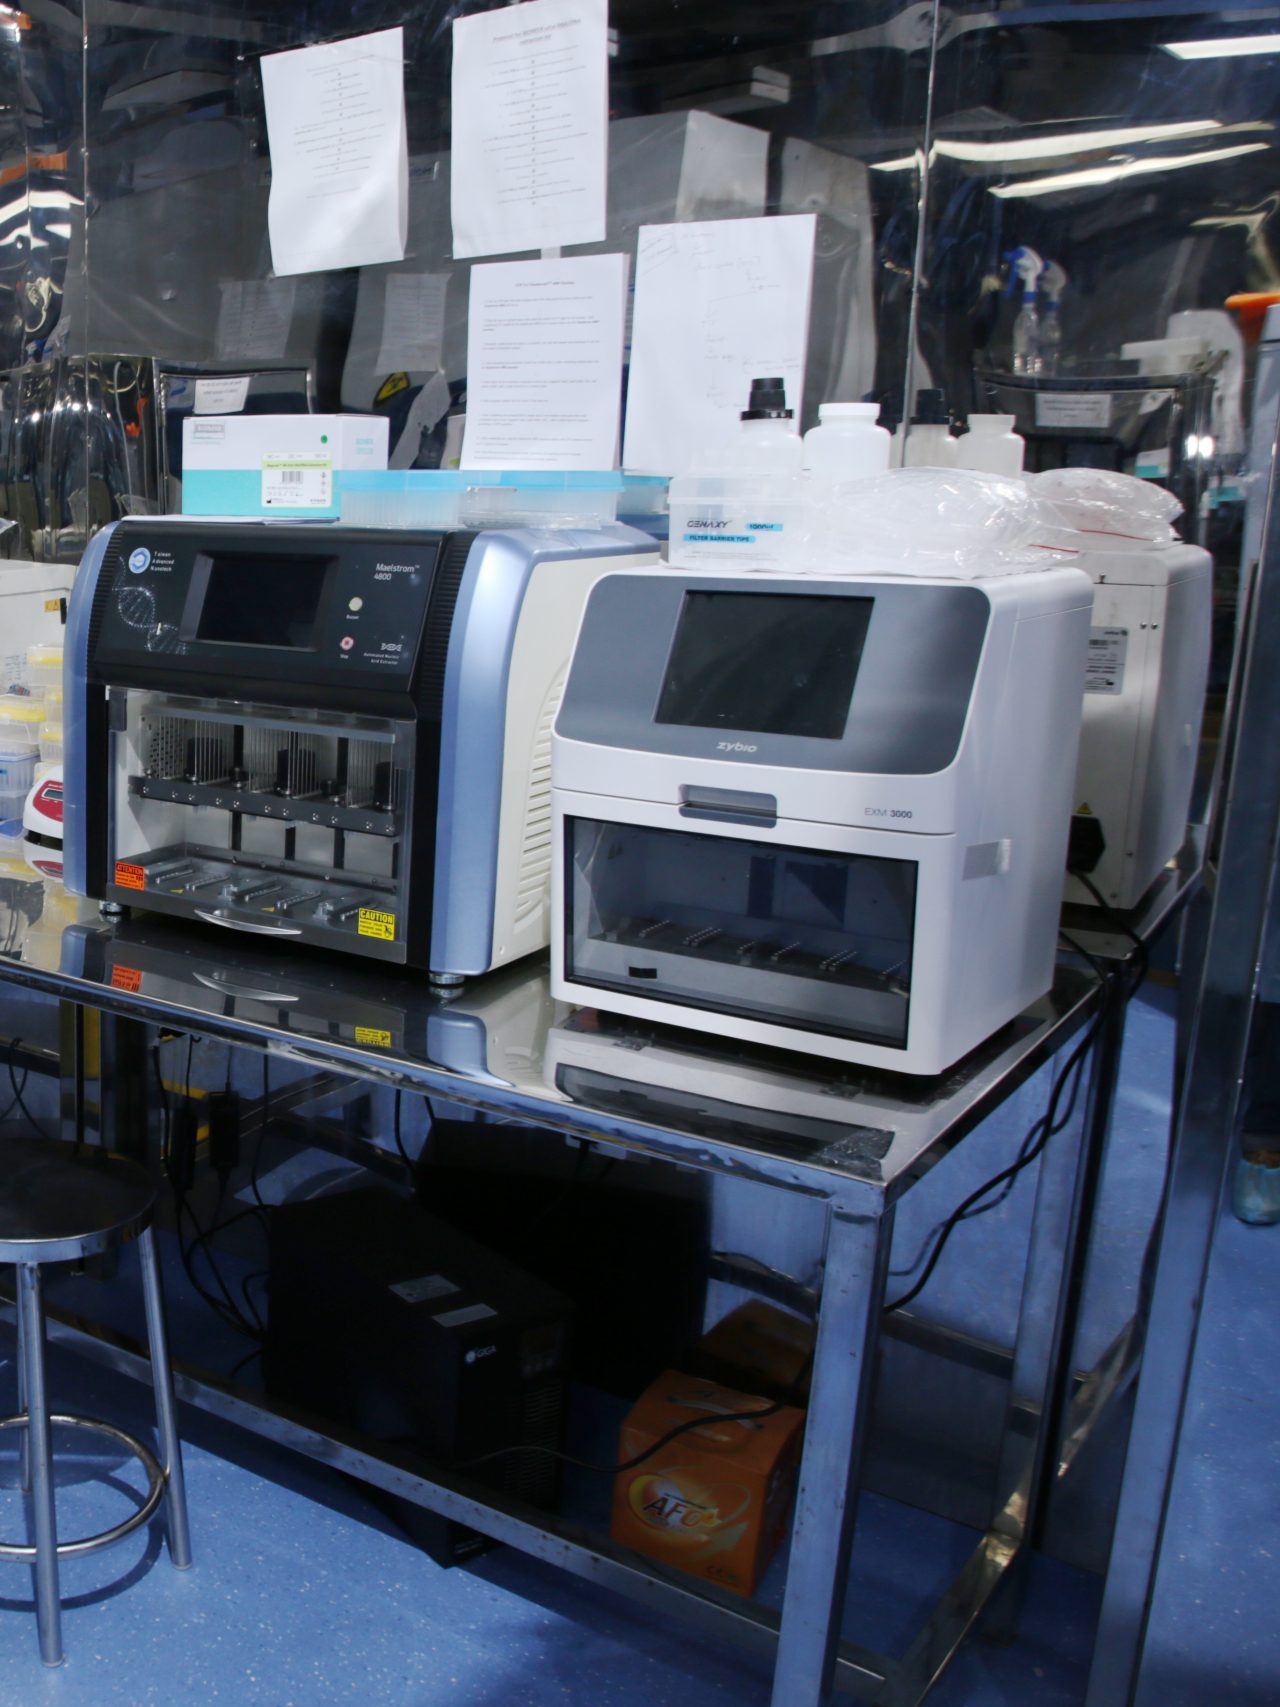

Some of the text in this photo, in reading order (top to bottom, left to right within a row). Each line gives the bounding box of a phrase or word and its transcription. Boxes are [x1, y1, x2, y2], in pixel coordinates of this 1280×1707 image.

[373, 572, 392, 581] 4800
[716, 741, 758, 753] zybio
[889, 809, 913, 819] 3000
[360, 910, 393, 925] CAUTION
